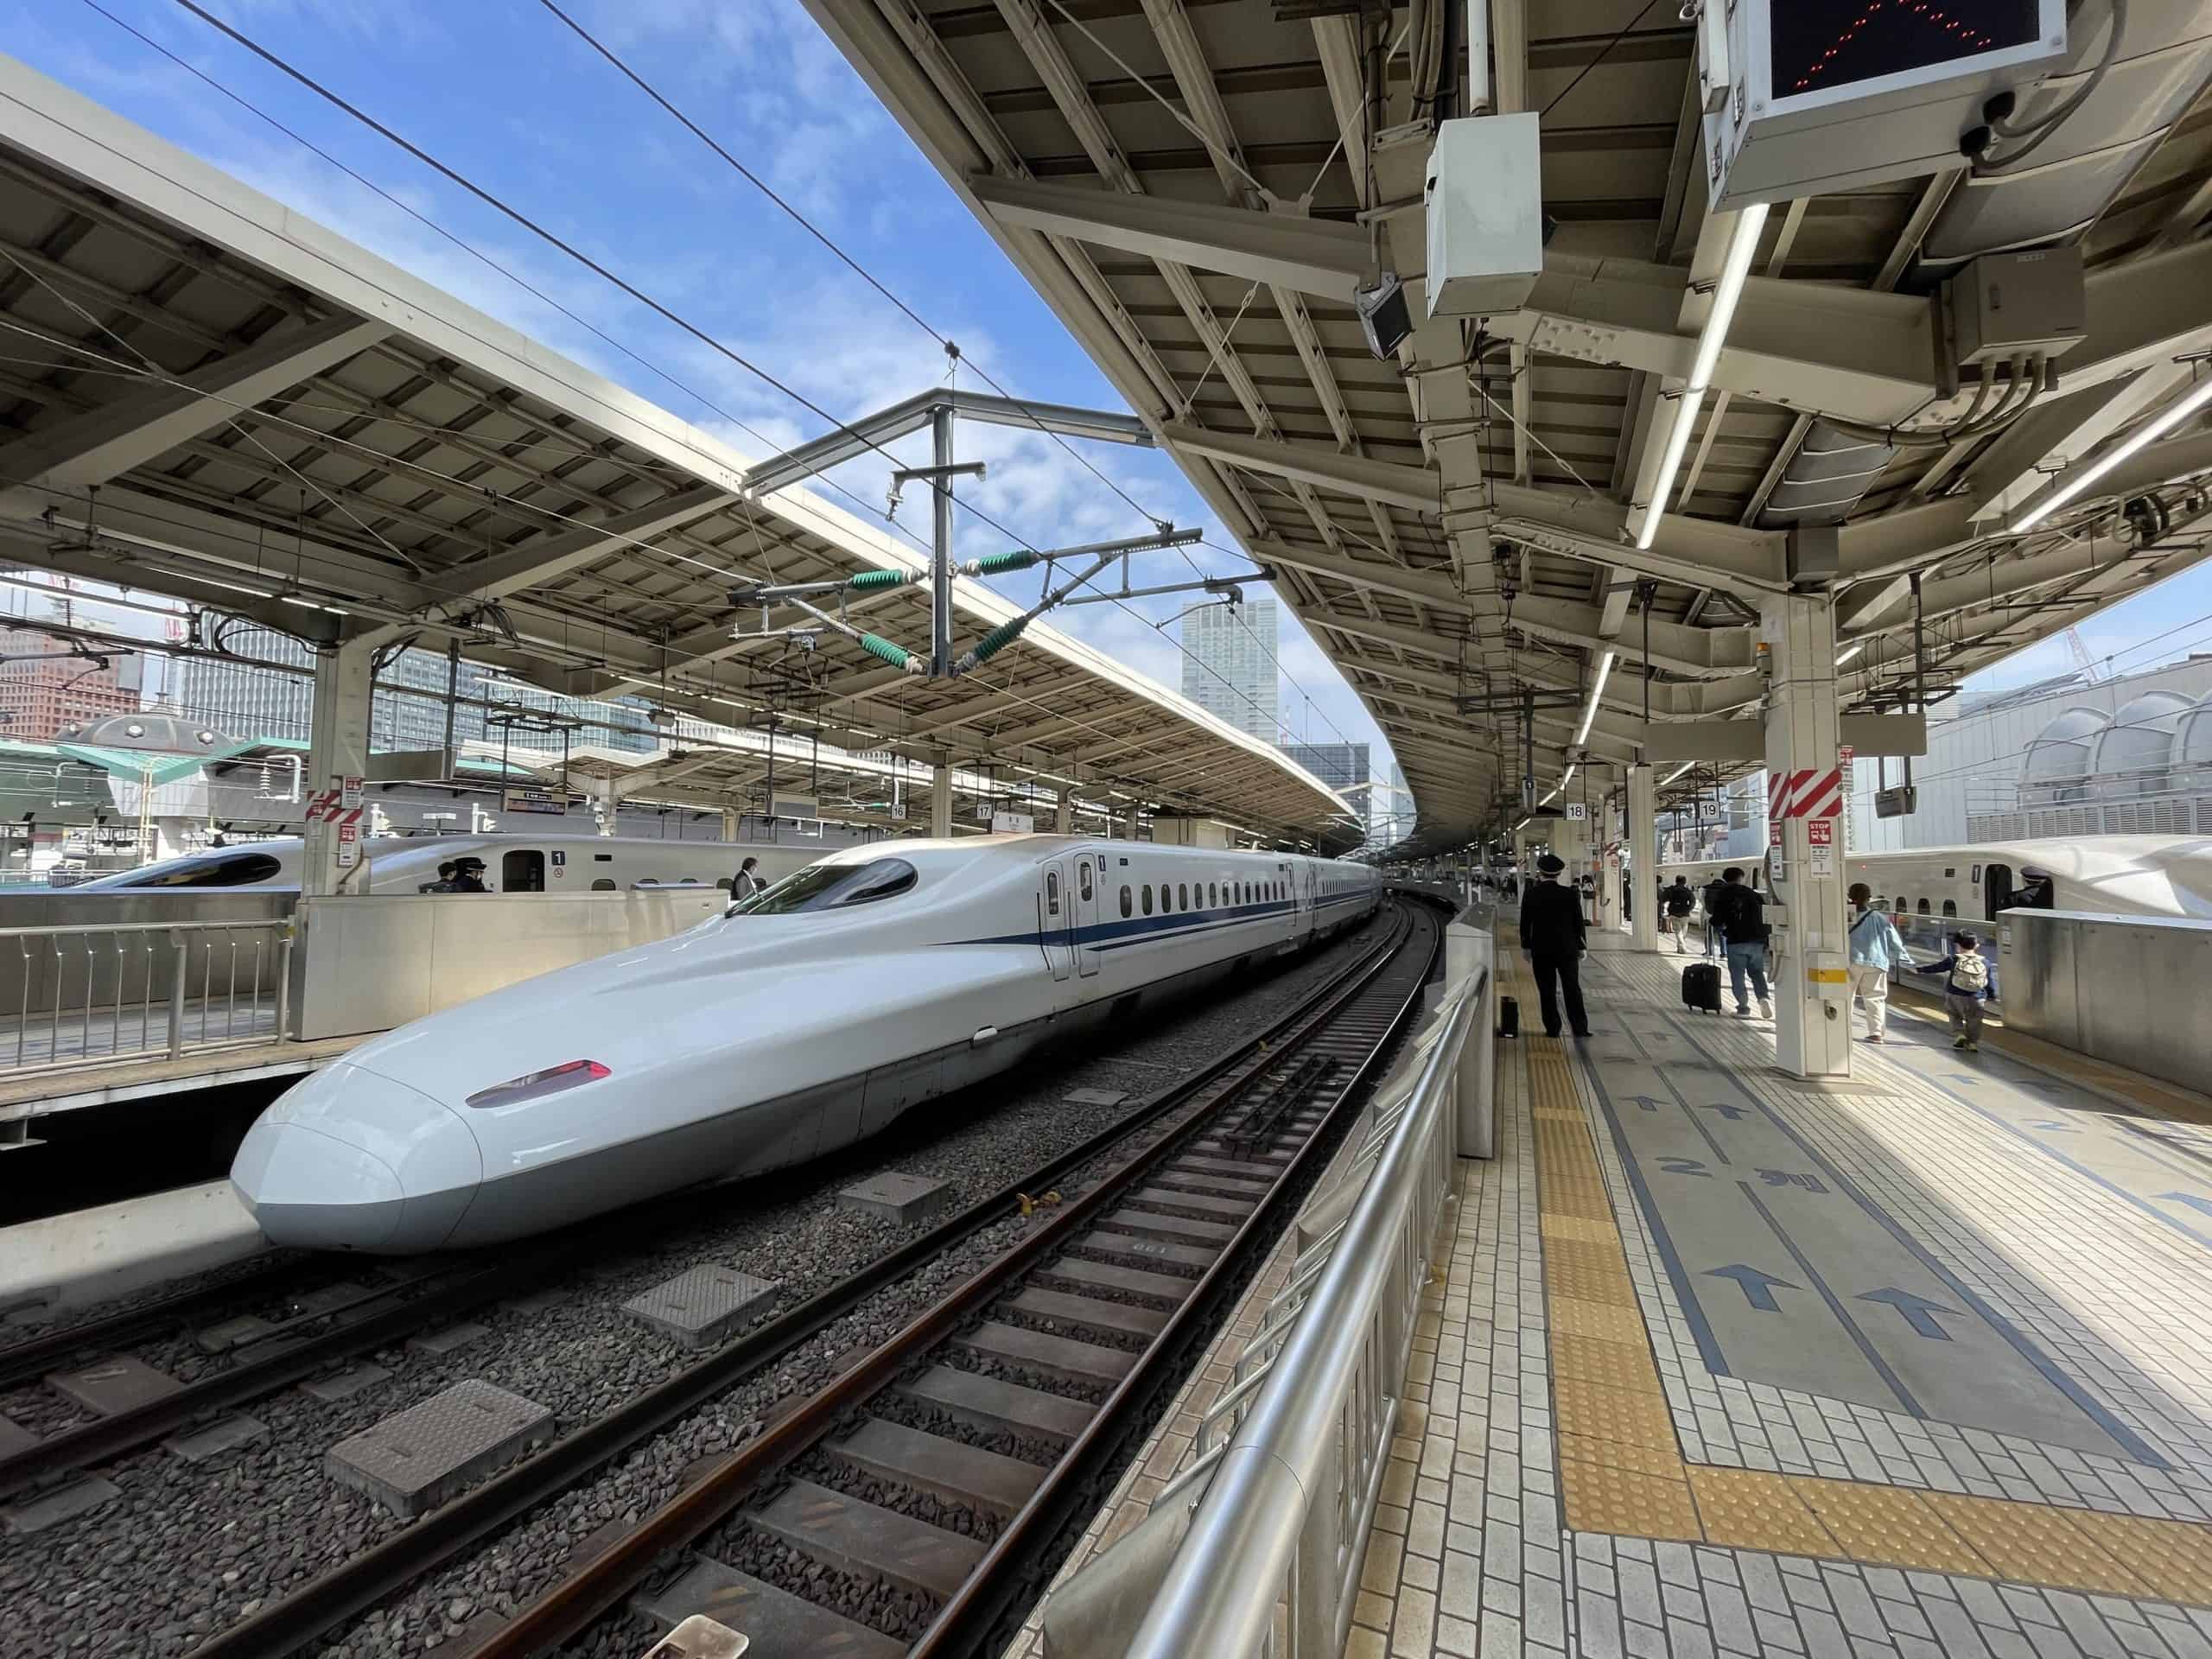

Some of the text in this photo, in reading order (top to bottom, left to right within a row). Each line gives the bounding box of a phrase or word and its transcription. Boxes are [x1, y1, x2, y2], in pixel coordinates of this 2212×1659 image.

[894, 808, 904, 817] 16
[980, 807, 989, 817] 17
[1569, 806, 1582, 817] 18
[1700, 804, 1716, 816] 19
